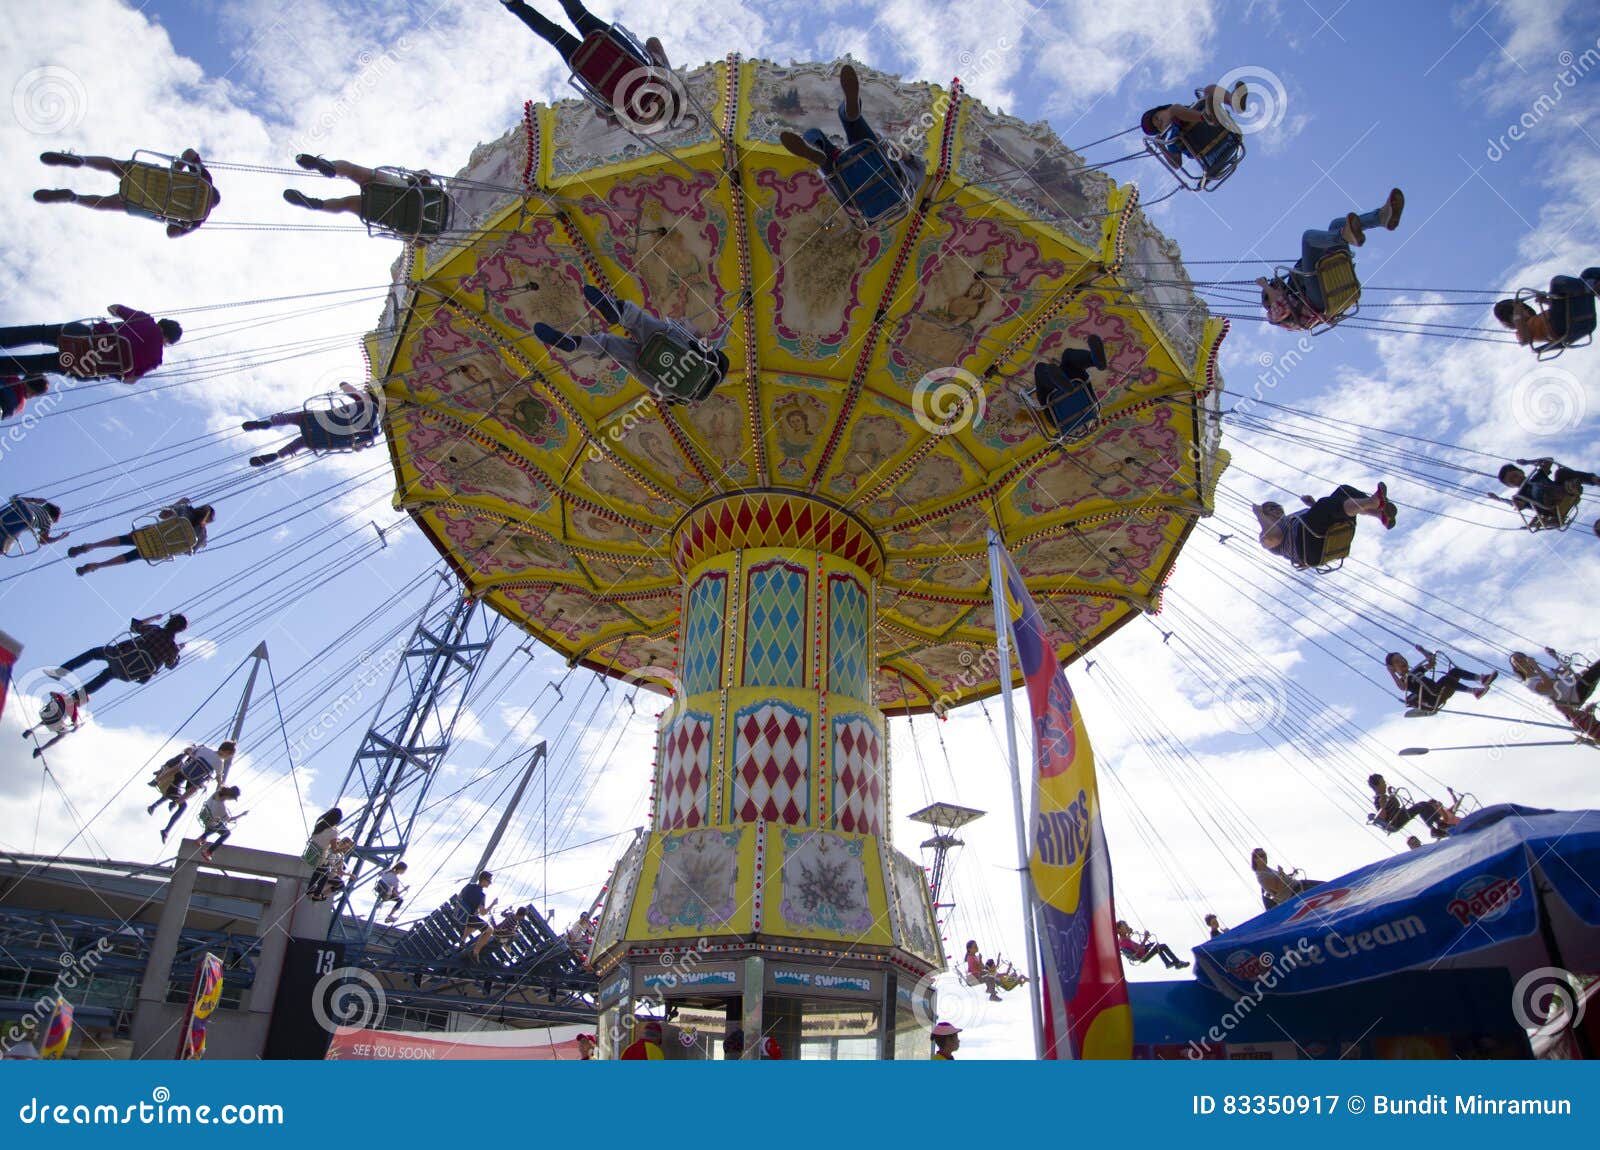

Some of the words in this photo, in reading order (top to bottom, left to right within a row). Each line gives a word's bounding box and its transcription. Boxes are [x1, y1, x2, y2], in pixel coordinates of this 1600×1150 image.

[1036, 788, 1089, 867] RIDES
[1324, 914, 1427, 957] Cream
[316, 950, 335, 976] 13
[352, 1043, 371, 1057] SEE
[372, 1044, 397, 1059] YOU
[398, 1046, 435, 1060] SOON!
